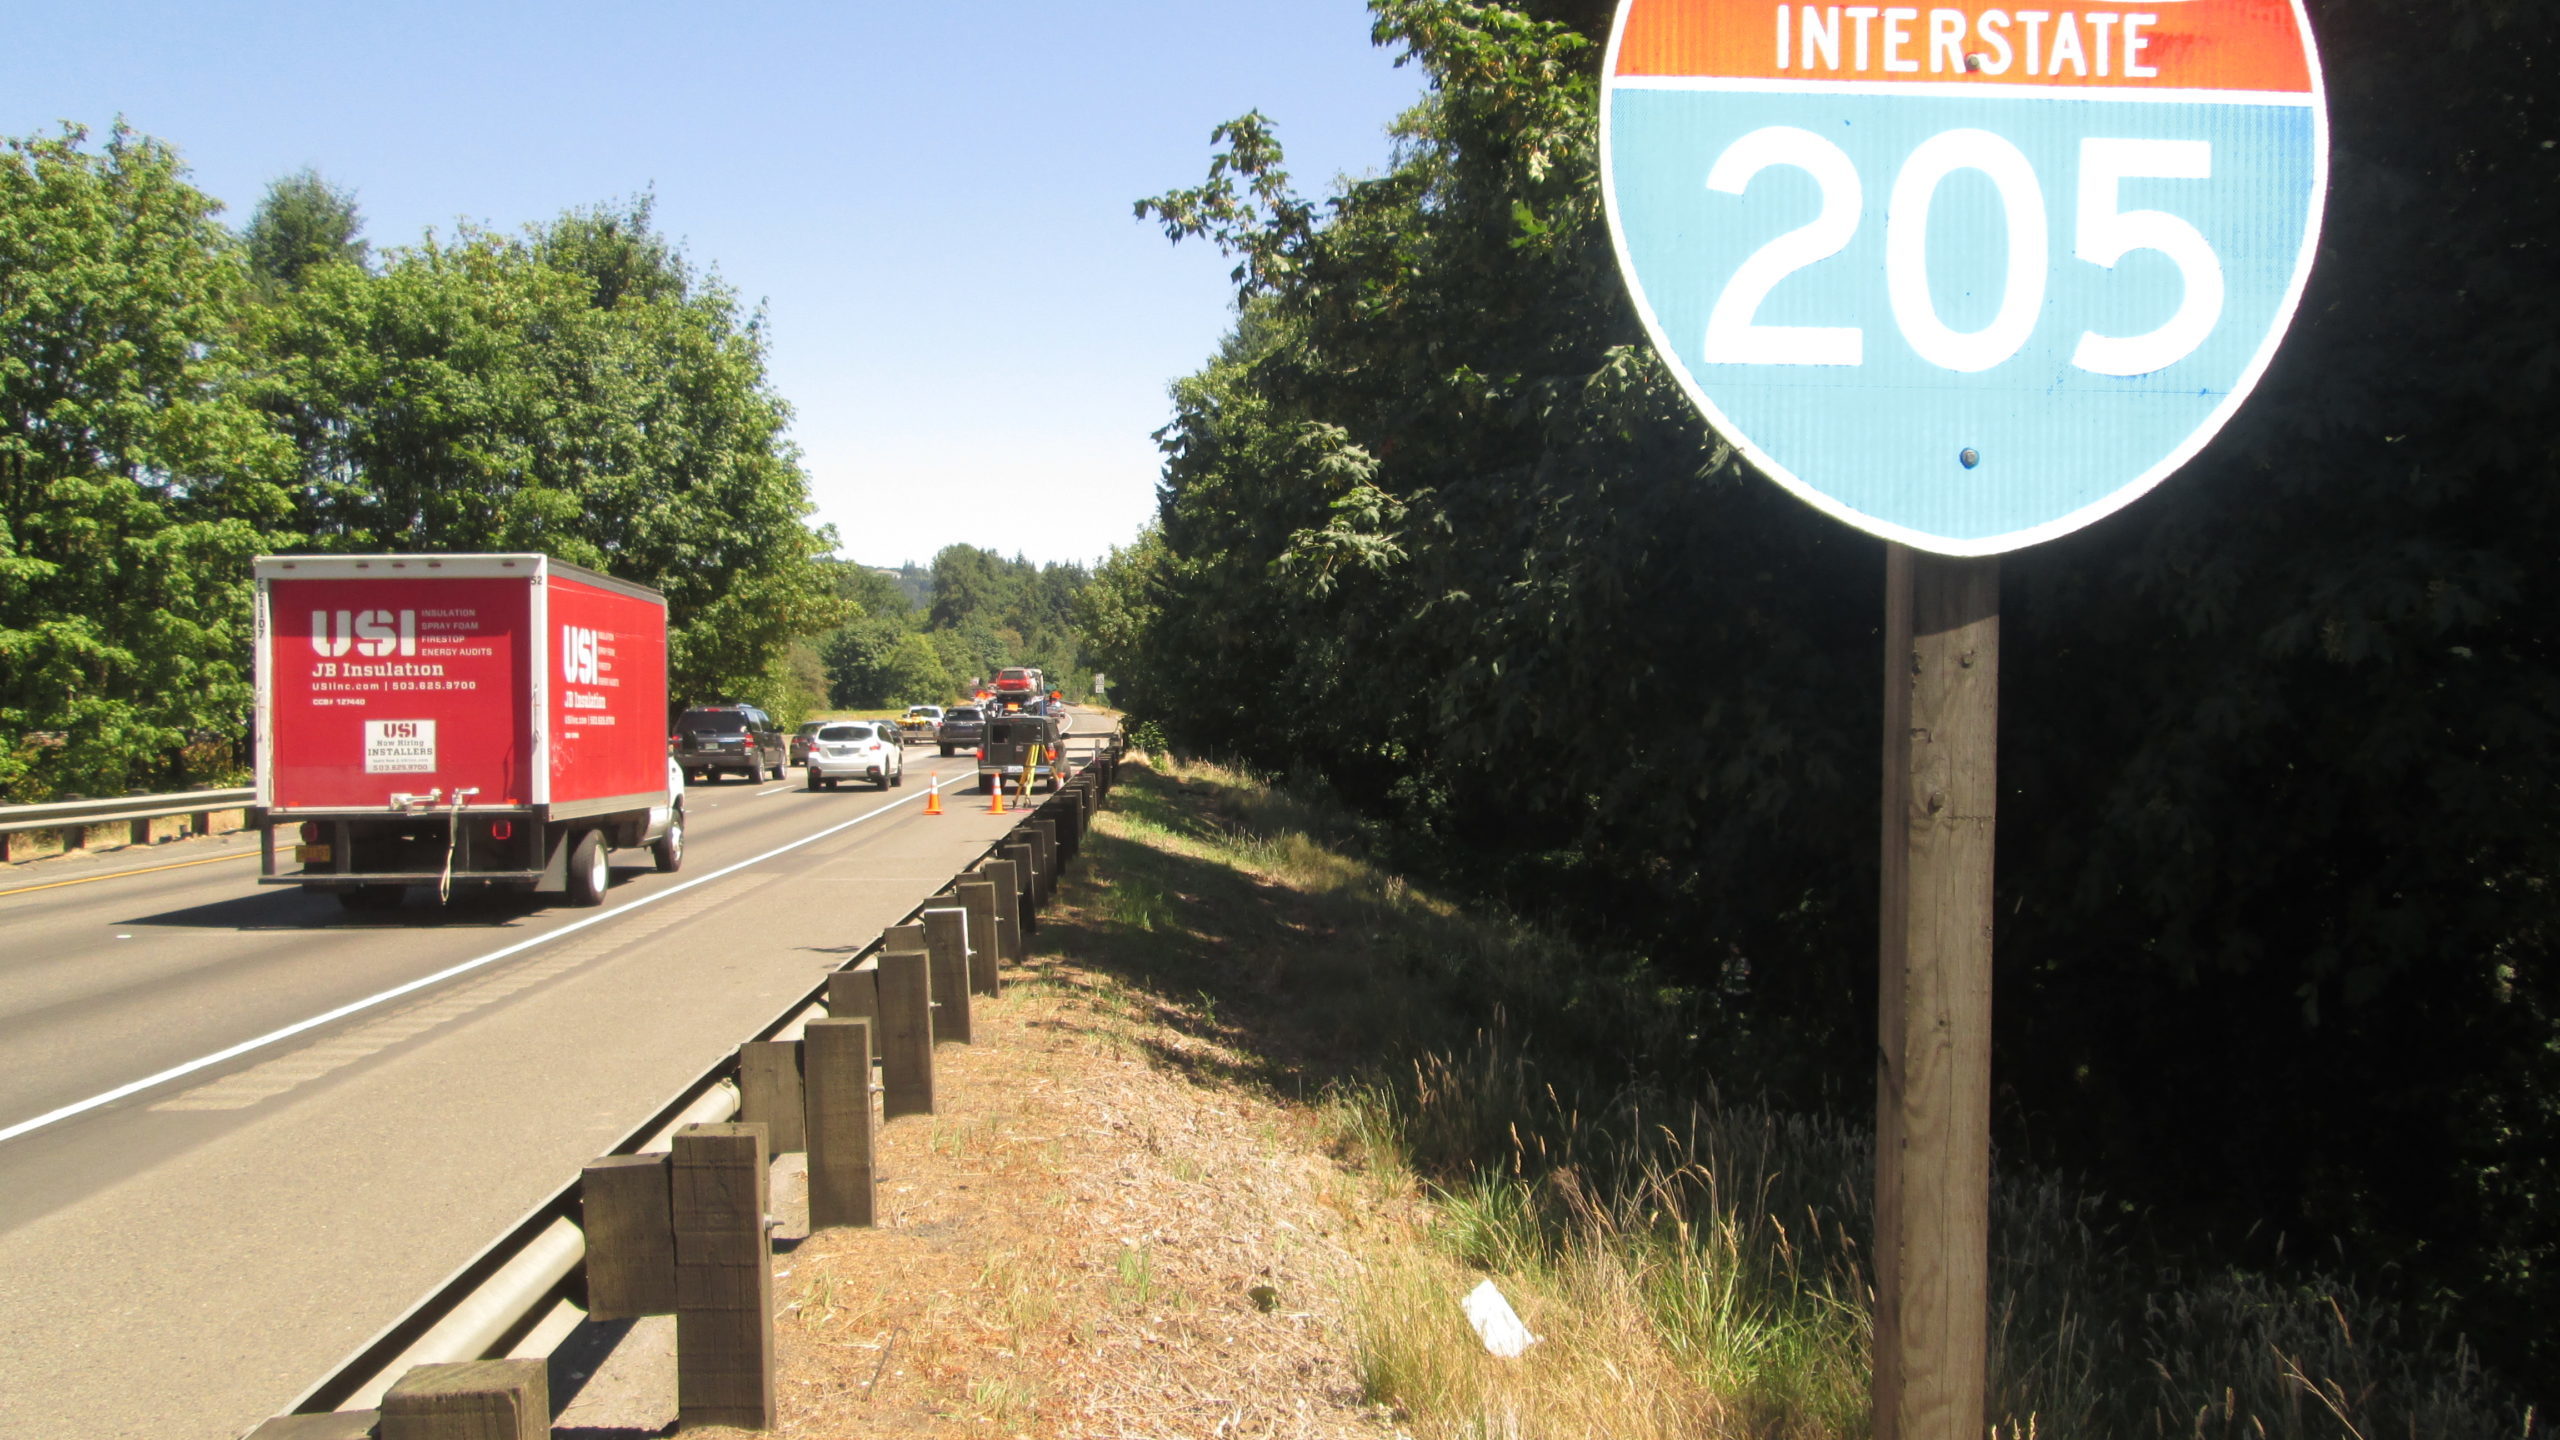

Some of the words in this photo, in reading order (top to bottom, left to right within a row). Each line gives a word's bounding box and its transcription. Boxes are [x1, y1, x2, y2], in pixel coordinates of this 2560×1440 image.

[1776, 4, 2158, 78] INTERSTATE
[1704, 125, 2225, 377] 205
[421, 609, 476, 617] INSULATION
[421, 622, 451, 630] SPRAY
[453, 621, 479, 630] FOAM
[312, 610, 415, 657] USI
[421, 635, 465, 643] FIRESTOP
[421, 648, 457, 656] ENERGY
[459, 647, 493, 656] AUDITS
[563, 624, 598, 685] USI
[312, 663, 337, 677] JB
[343, 662, 445, 677] Insulation
[392, 681, 477, 690] 503.625.9700
[383, 723, 417, 738] USI
[367, 748, 433, 756] INSTALLERS
